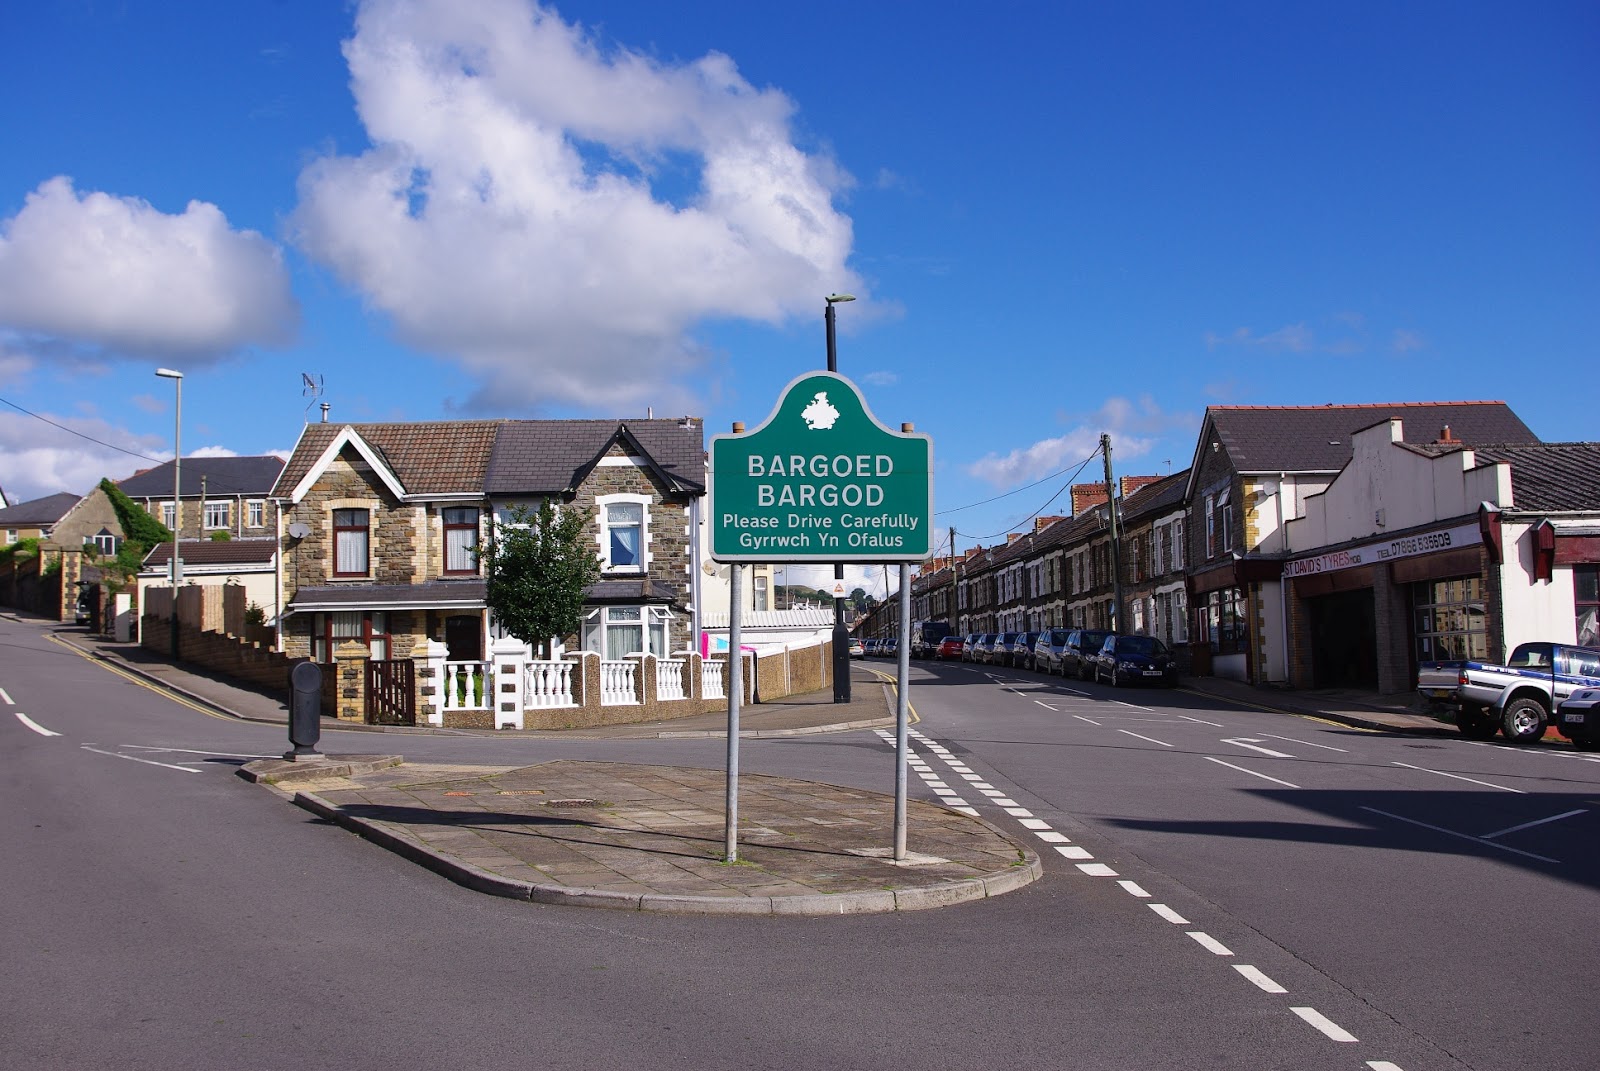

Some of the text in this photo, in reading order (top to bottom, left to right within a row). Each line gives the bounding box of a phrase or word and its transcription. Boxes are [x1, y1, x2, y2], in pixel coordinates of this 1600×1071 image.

[748, 455, 894, 477] BARGOED
[758, 484, 884, 507] BARGOD
[723, 513, 918, 531] Please Drive Carefully
[739, 532, 903, 550] Gyrrwch Yn Ofalus
[1285, 561, 1293, 575] ST
[1294, 557, 1321, 574] DAVID'S
[1322, 551, 1350, 569] TYRES
[1391, 538, 1417, 556] 07866
[1418, 532, 1452, 551] 535609
